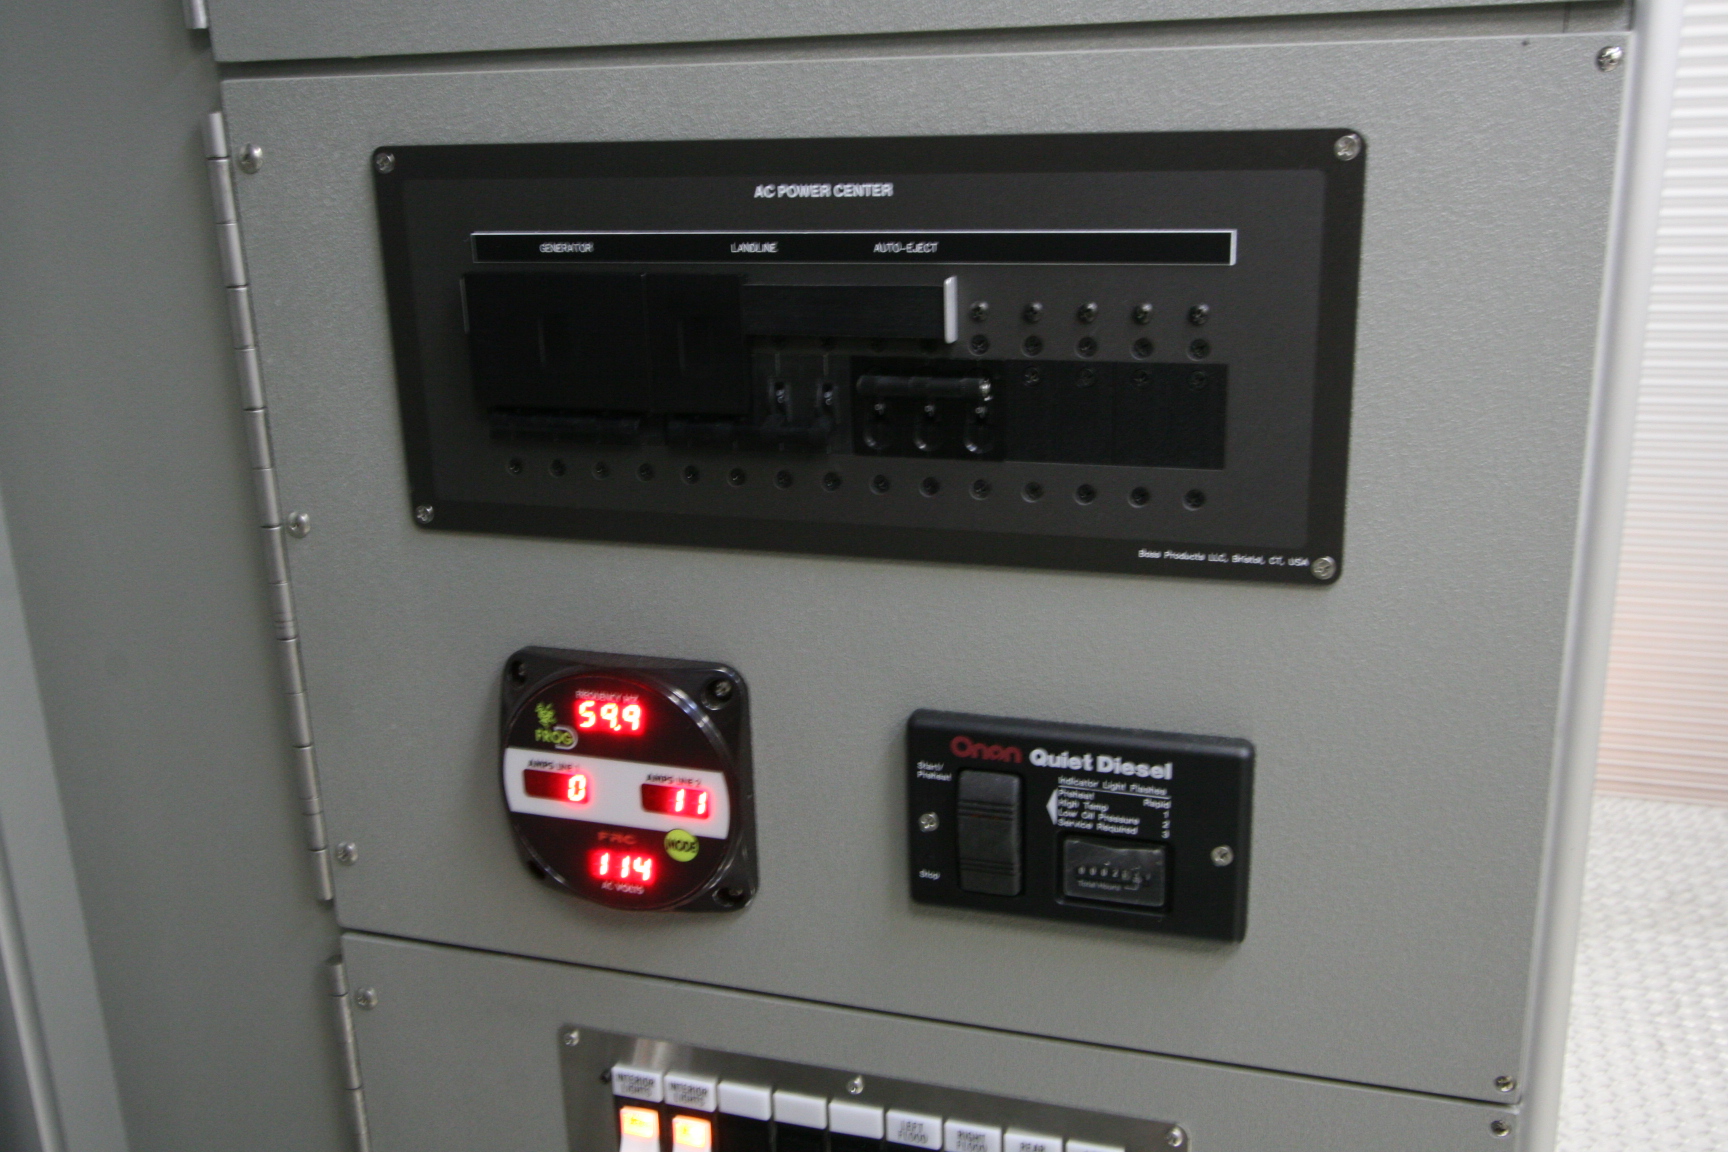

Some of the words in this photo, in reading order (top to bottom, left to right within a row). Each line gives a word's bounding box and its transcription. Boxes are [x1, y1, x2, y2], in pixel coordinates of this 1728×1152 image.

[754, 184, 776, 198] AC
[778, 183, 831, 198] POWER
[833, 182, 894, 197] CENTER
[539, 241, 594, 253] GENERATOR
[730, 241, 778, 253] LANDLINE
[873, 241, 938, 254] AUTO-EJECT
[1164, 550, 1206, 561] Products
[1288, 557, 1310, 567] USA
[578, 700, 641, 731] 59.9
[534, 729, 574, 746] FROG
[951, 735, 1023, 763] Onan
[1029, 748, 1094, 772] Quiet
[1096, 754, 1173, 780] Diesel
[567, 773, 587, 802] 0
[1058, 775, 1099, 788] Indicator
[1102, 780, 1127, 792] Light
[1130, 784, 1168, 796] Flashes
[674, 788, 707, 815] 11
[1058, 789, 1095, 800] Preheat
[1143, 798, 1172, 810] Rapid
[1058, 799, 1080, 809] High
[1083, 801, 1109, 812] Temp
[1058, 809, 1078, 818] Low
[1081, 811, 1095, 820] Oil
[1098, 813, 1140, 825] Pressure
[1161, 820, 1170, 829] 2
[1058, 819, 1093, 830] Service
[1097, 823, 1138, 835] Required
[1161, 830, 1170, 839] 3
[666, 839, 698, 854] MODE
[600, 852, 652, 881] 114
[919, 868, 941, 881] Stop
[957, 1130, 986, 1143] RIGHT
